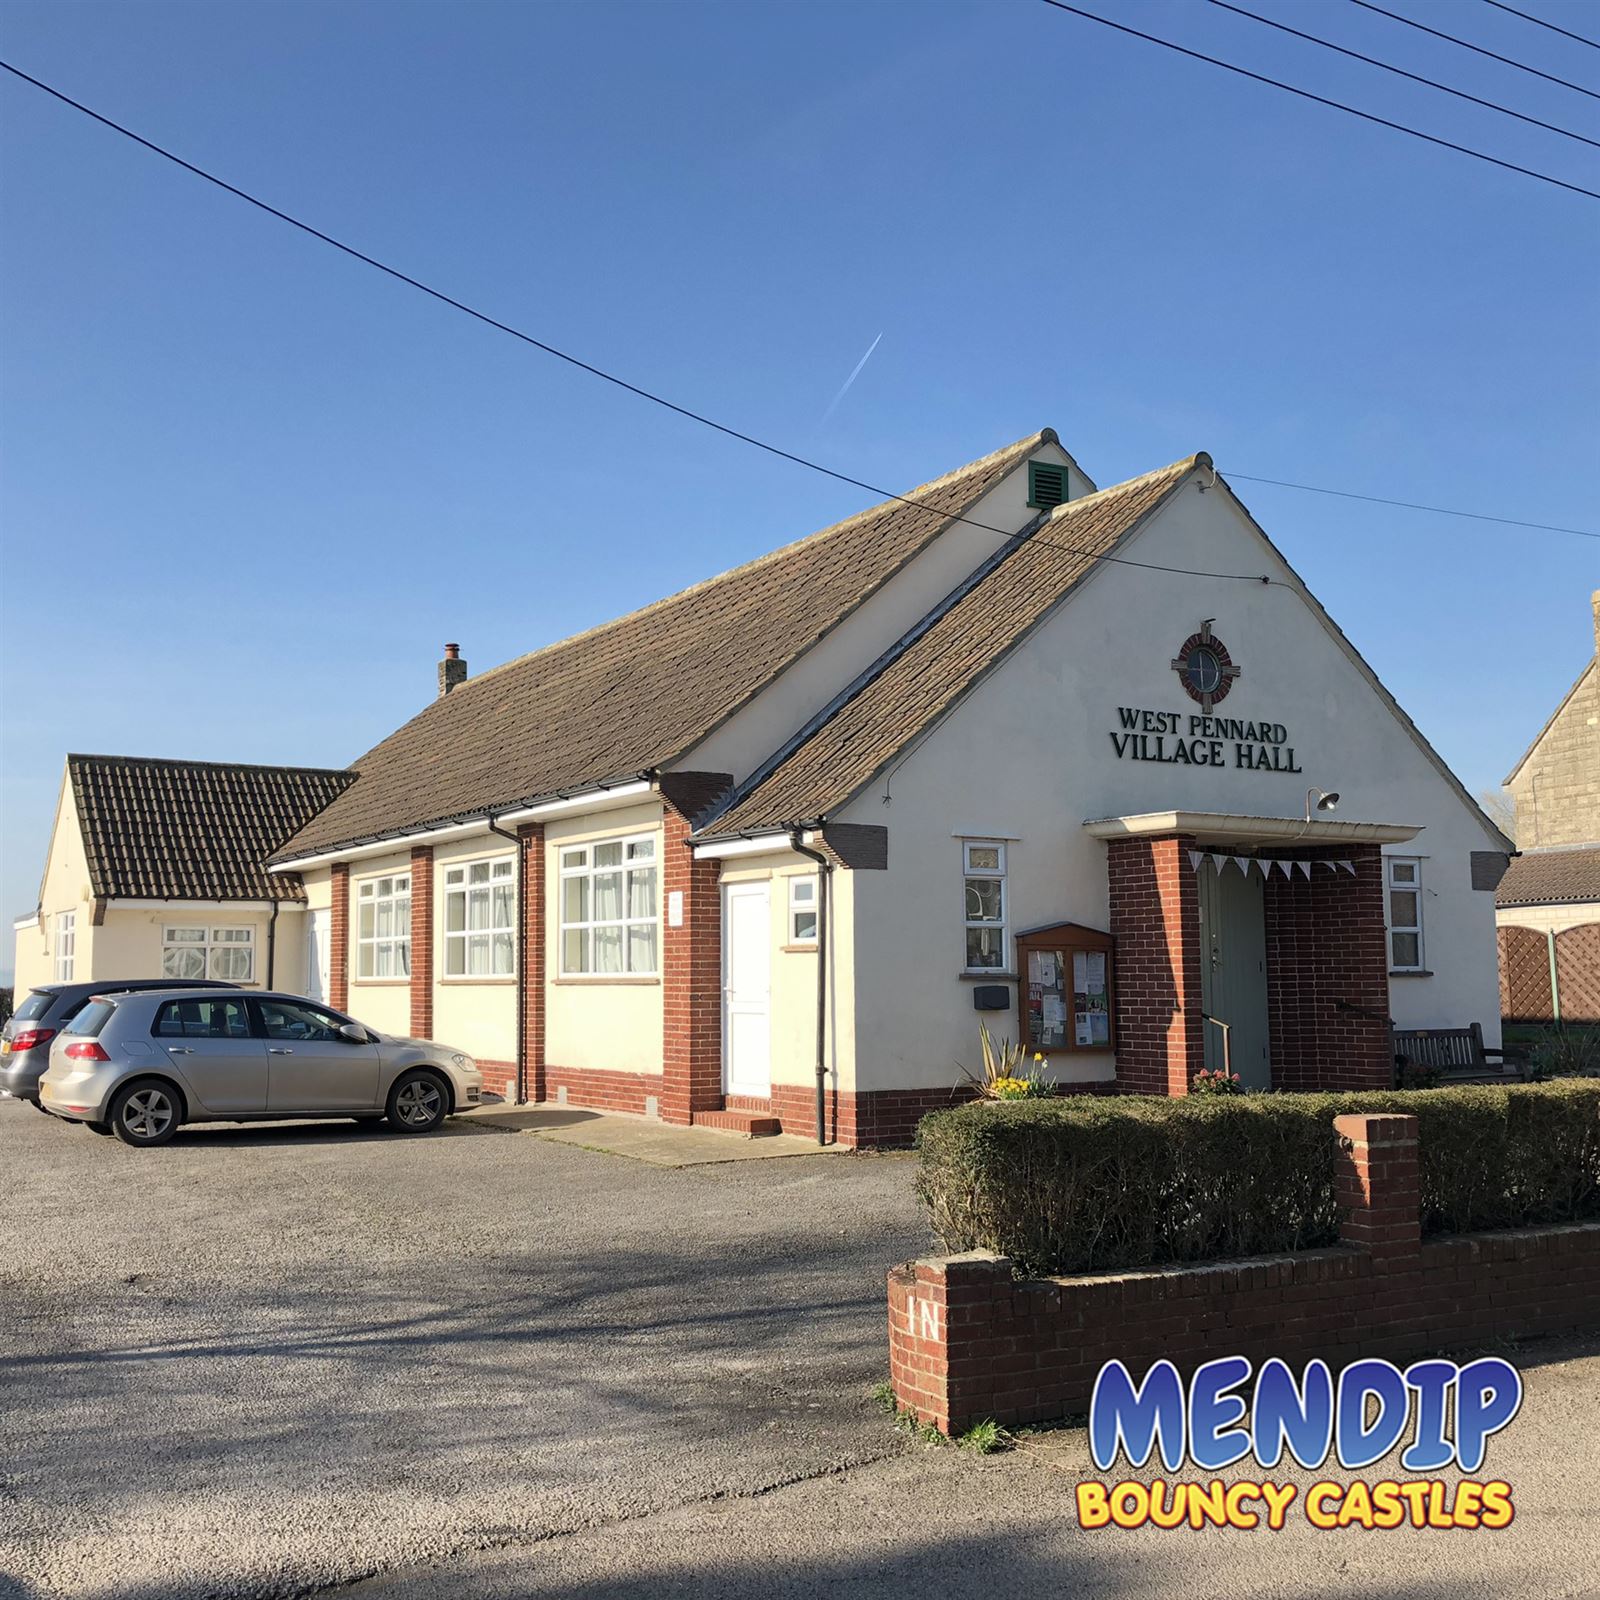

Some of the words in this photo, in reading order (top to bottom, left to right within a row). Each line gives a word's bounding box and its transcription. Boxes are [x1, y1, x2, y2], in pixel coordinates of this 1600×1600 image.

[1118, 707, 1181, 735] WEST
[1189, 715, 1288, 744] PENNARD
[1110, 732, 1225, 767] VILLAGE
[1236, 743, 1302, 773] HALL
[908, 1295, 939, 1341] IN
